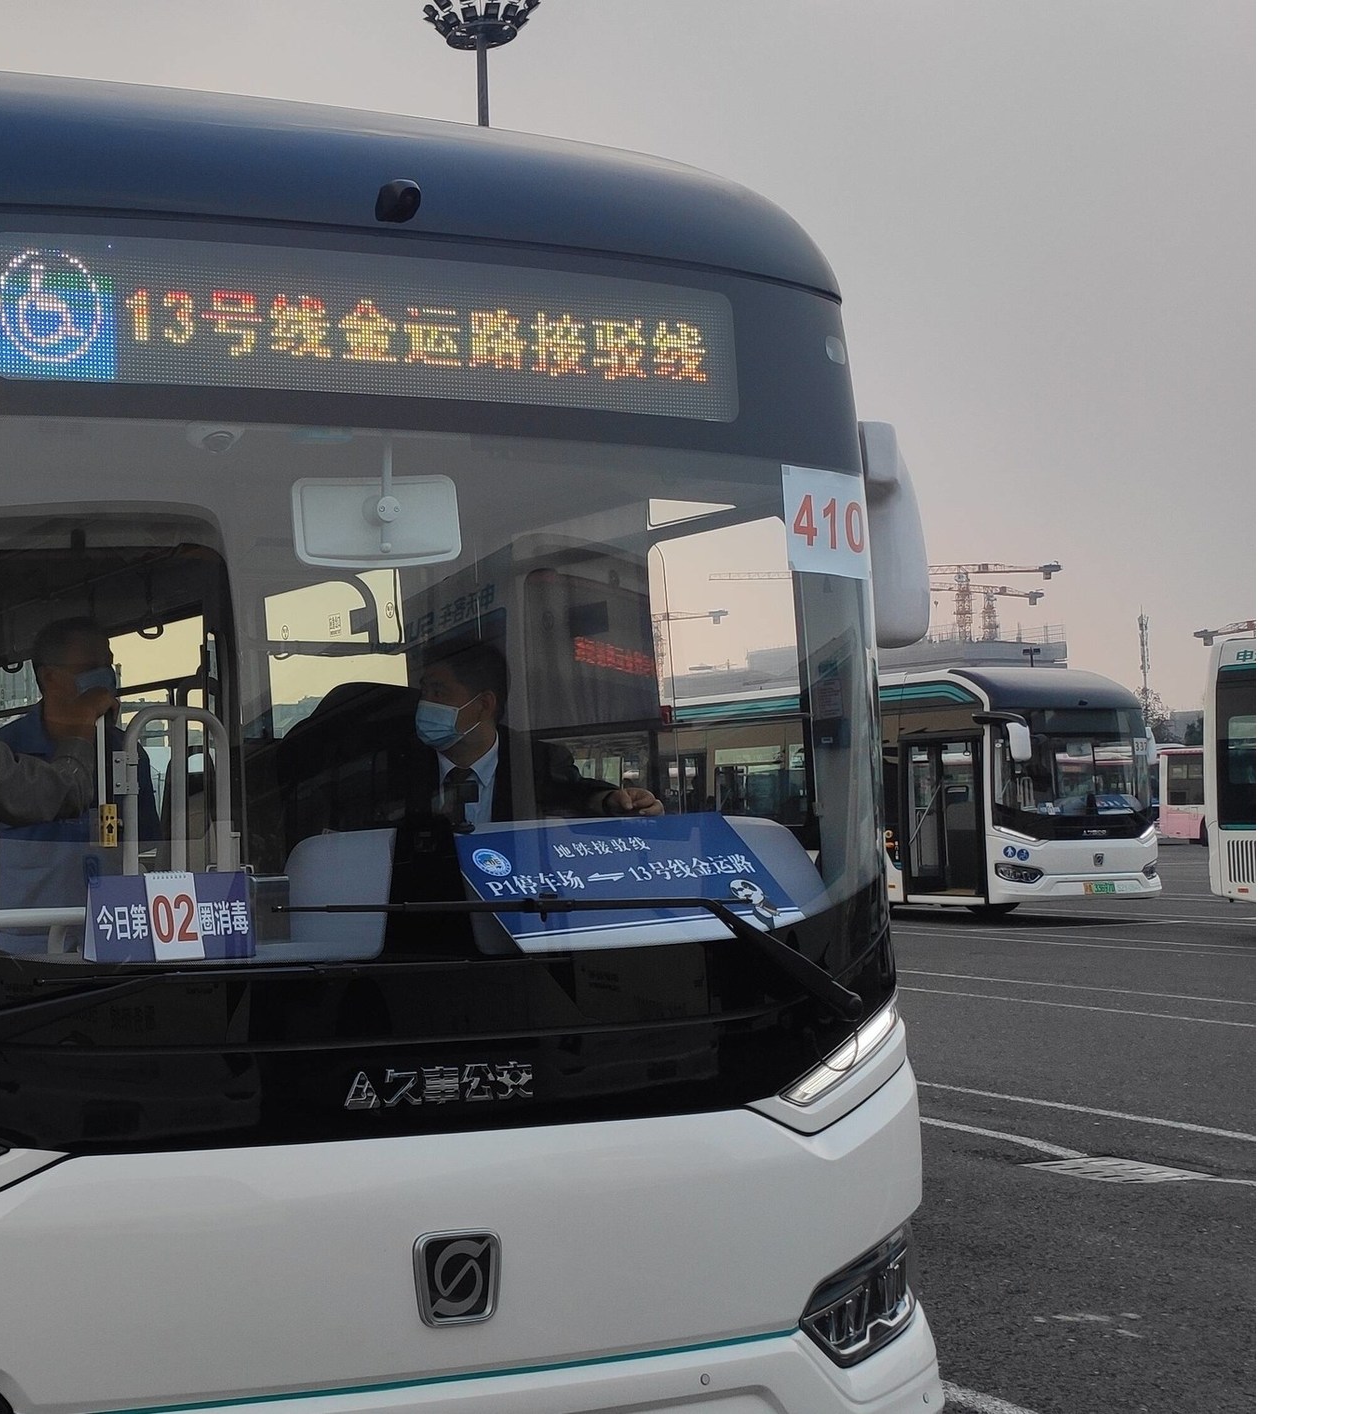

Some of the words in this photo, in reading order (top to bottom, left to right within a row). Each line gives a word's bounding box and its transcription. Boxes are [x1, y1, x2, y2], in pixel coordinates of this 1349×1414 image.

[125, 288, 708, 383] 13号线金运路接驳线
[792, 494, 866, 554] 410
[1236, 649, 1256, 662] 申
[553, 836, 650, 859] 地铁接驳线
[485, 870, 585, 897] P1停车场
[628, 853, 756, 882] 13号线金运路
